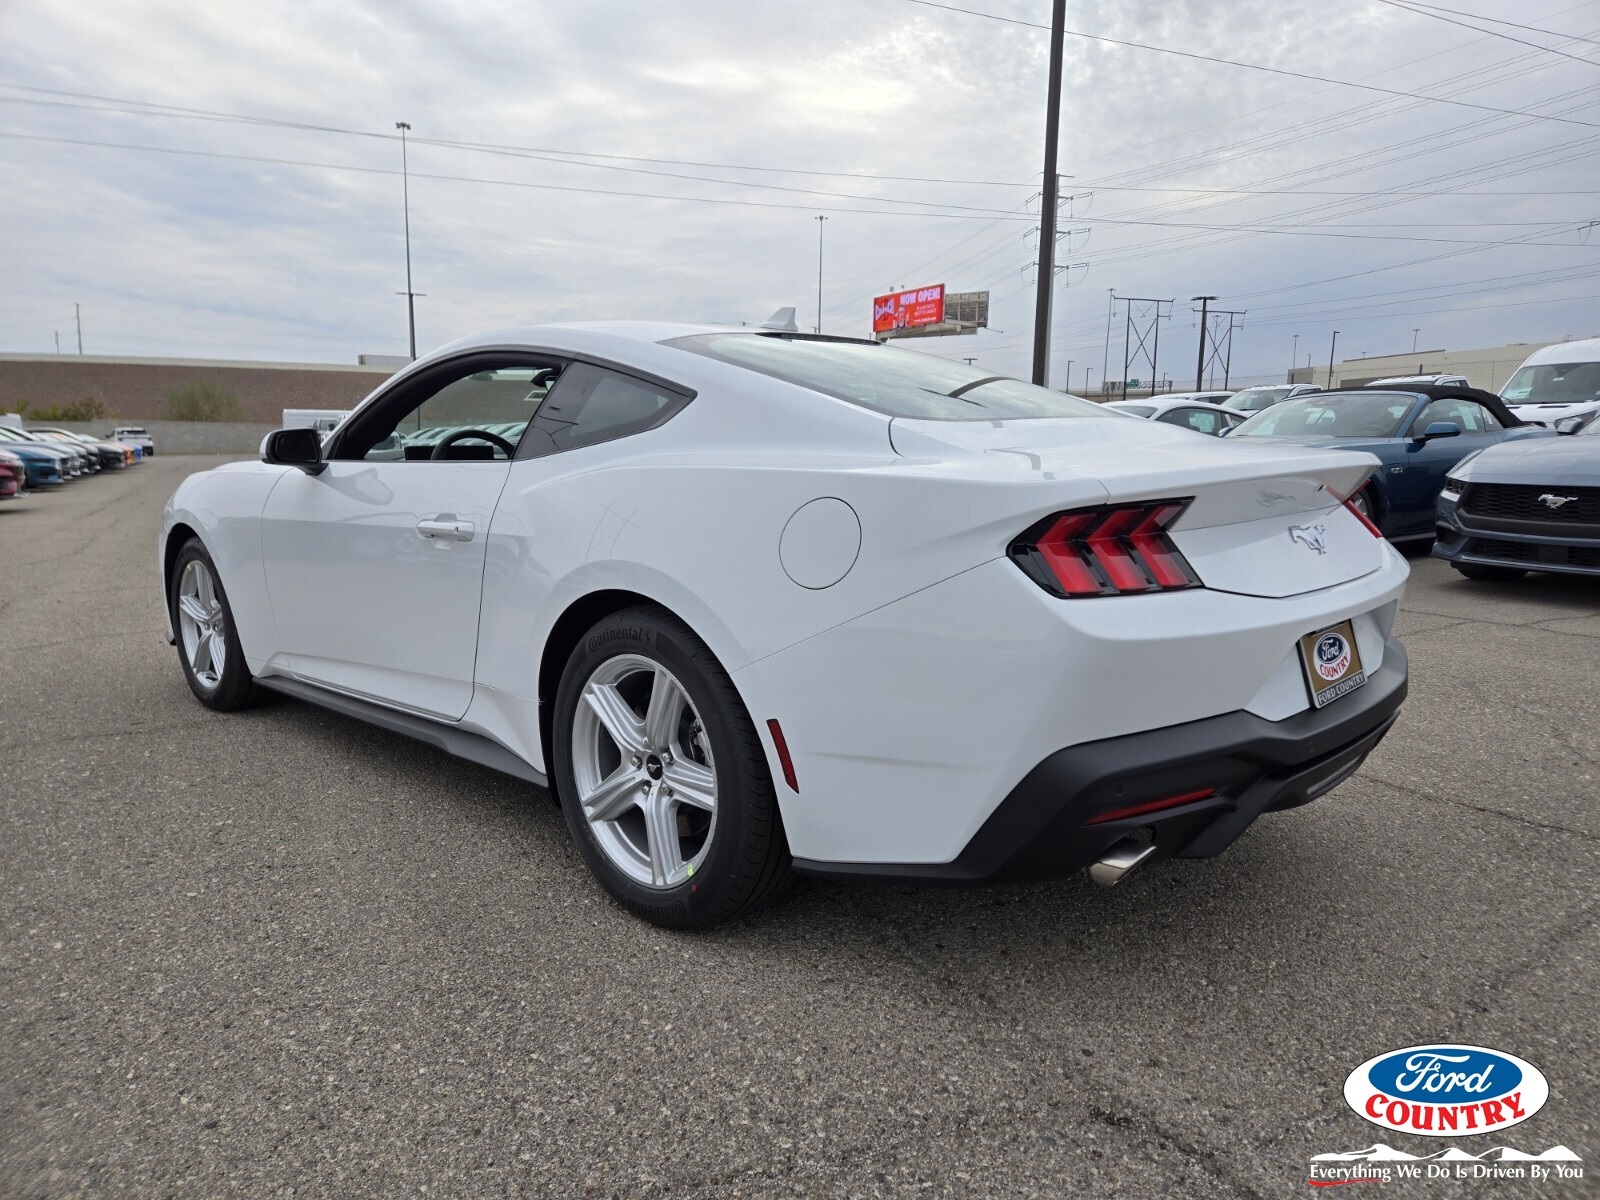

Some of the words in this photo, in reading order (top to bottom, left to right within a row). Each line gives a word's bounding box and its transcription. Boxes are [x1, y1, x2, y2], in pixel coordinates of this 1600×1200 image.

[900, 291, 917, 305] NOW
[918, 286, 941, 303] OPEN!
[588, 627, 643, 652] Continental
[1321, 638, 1340, 661] Ford
[1319, 654, 1349, 678] COUNTRY
[1317, 688, 1336, 704] FORD
[1336, 674, 1364, 694] COUNTRY
